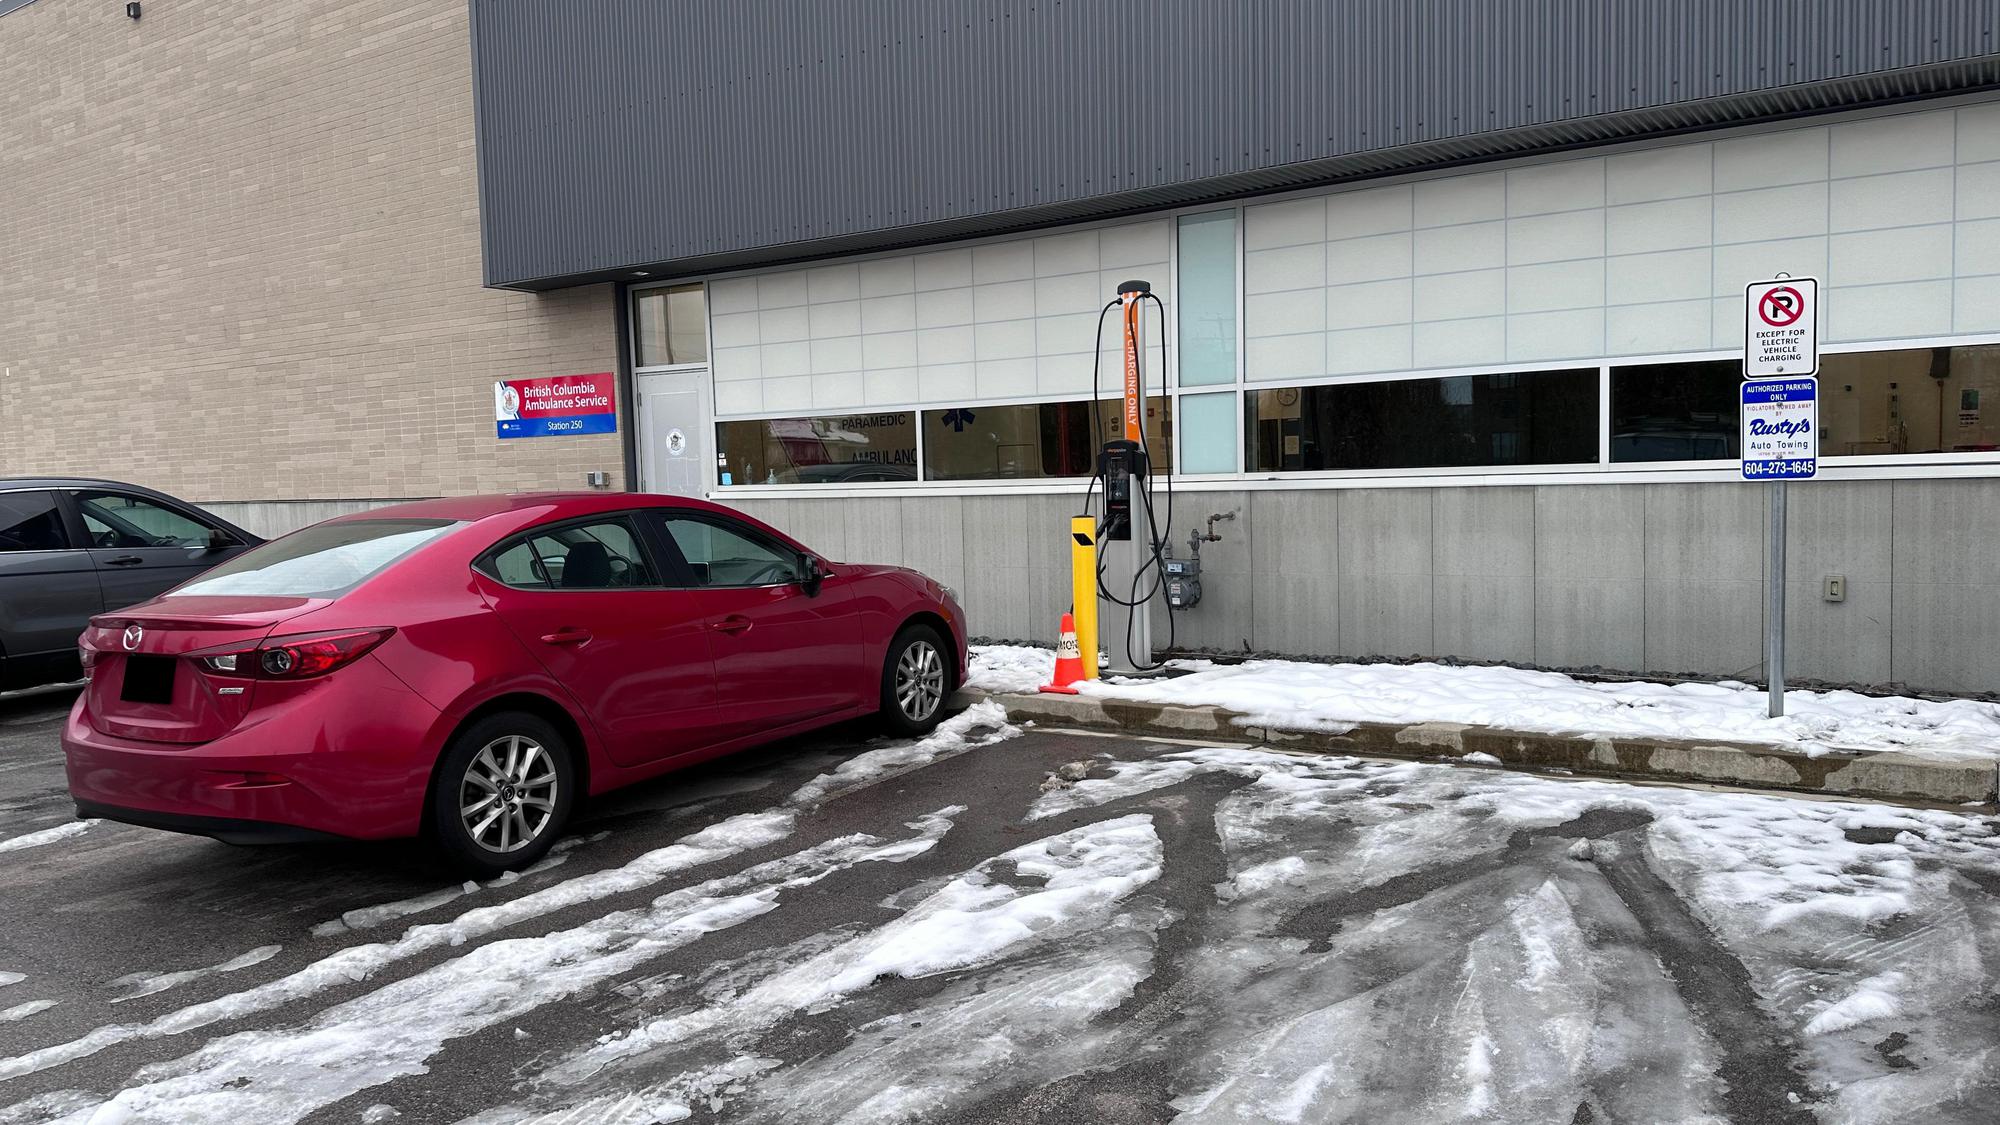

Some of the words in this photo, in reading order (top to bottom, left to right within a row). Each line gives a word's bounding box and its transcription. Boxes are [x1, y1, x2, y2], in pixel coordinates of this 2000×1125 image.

[1756, 330, 1785, 338] EXCEPT
[1762, 338, 1799, 346] ELECTRIC
[1763, 346, 1797, 354] VEHICLE
[1758, 354, 1802, 362] CHARGING
[1127, 339, 1137, 395] CHARGING
[524, 385, 551, 398] British
[553, 382, 595, 396] Columbia
[1746, 384, 1784, 393] AUTHORIZED
[1785, 383, 1812, 391] PARKING
[1770, 393, 1787, 401] ONLY
[525, 397, 574, 411] Ambulance
[576, 395, 608, 407] Service
[1127, 397, 1137, 425] ONLY
[548, 421, 570, 430] Station
[571, 420, 583, 429] 250
[842, 414, 906, 430] PARAMEDIC
[1749, 418, 1811, 439] Rusty's
[1750, 441, 1771, 449] Auto
[1777, 440, 1808, 449] Towing
[1745, 461, 1814, 475] 604-273-1645
